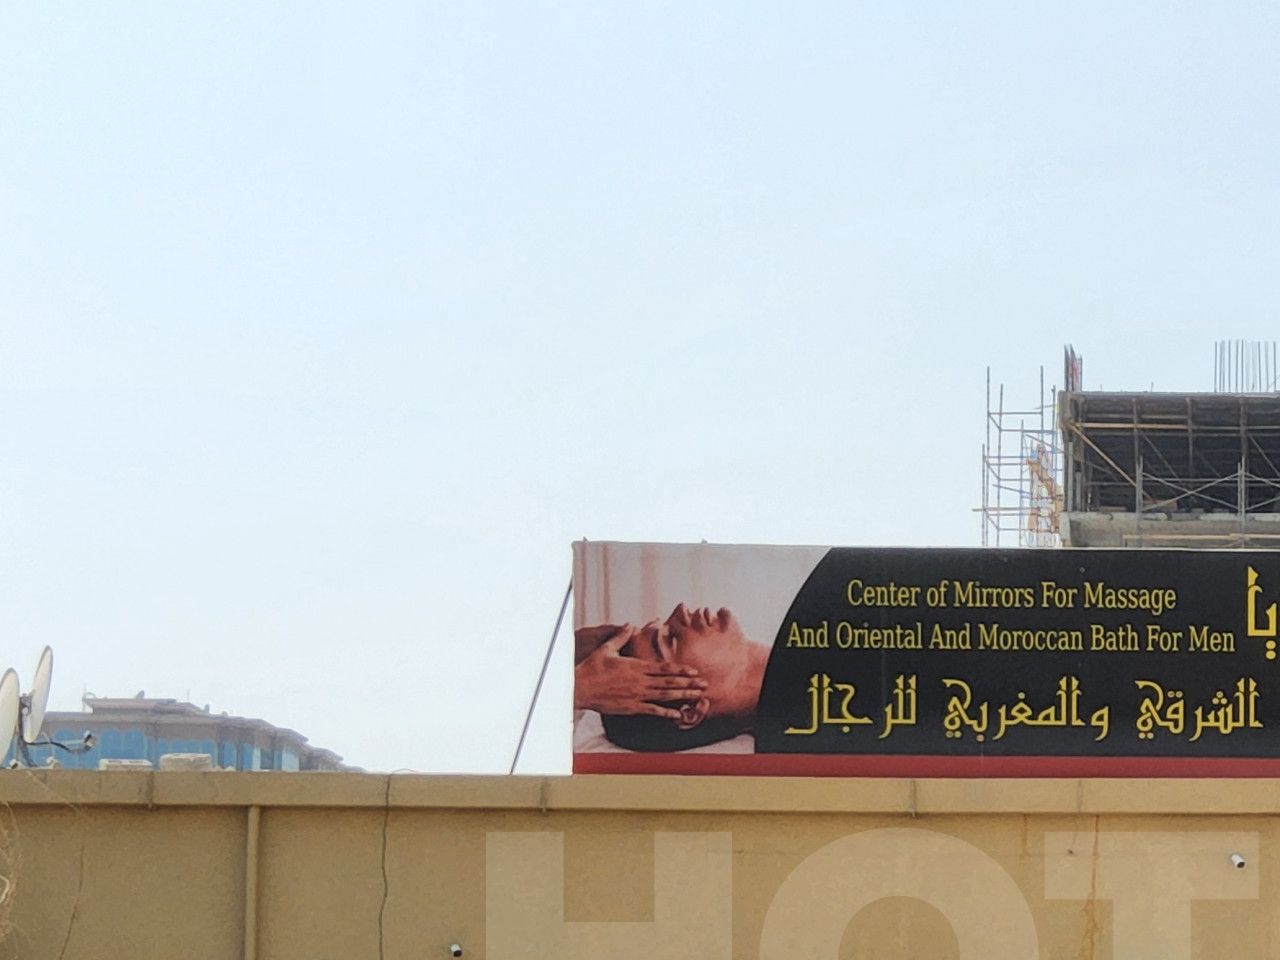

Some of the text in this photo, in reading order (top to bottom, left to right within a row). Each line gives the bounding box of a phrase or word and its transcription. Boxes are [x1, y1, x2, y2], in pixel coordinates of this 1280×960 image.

[846, 579, 1177, 614] Center of Mirrors For Massage
[786, 621, 1236, 653] And Oriental And Moroccan Bath For Men
[783, 673, 918, 740] للرجال
[942, 675, 1110, 742] والمغربي
[1134, 677, 1264, 742] الشرقي
